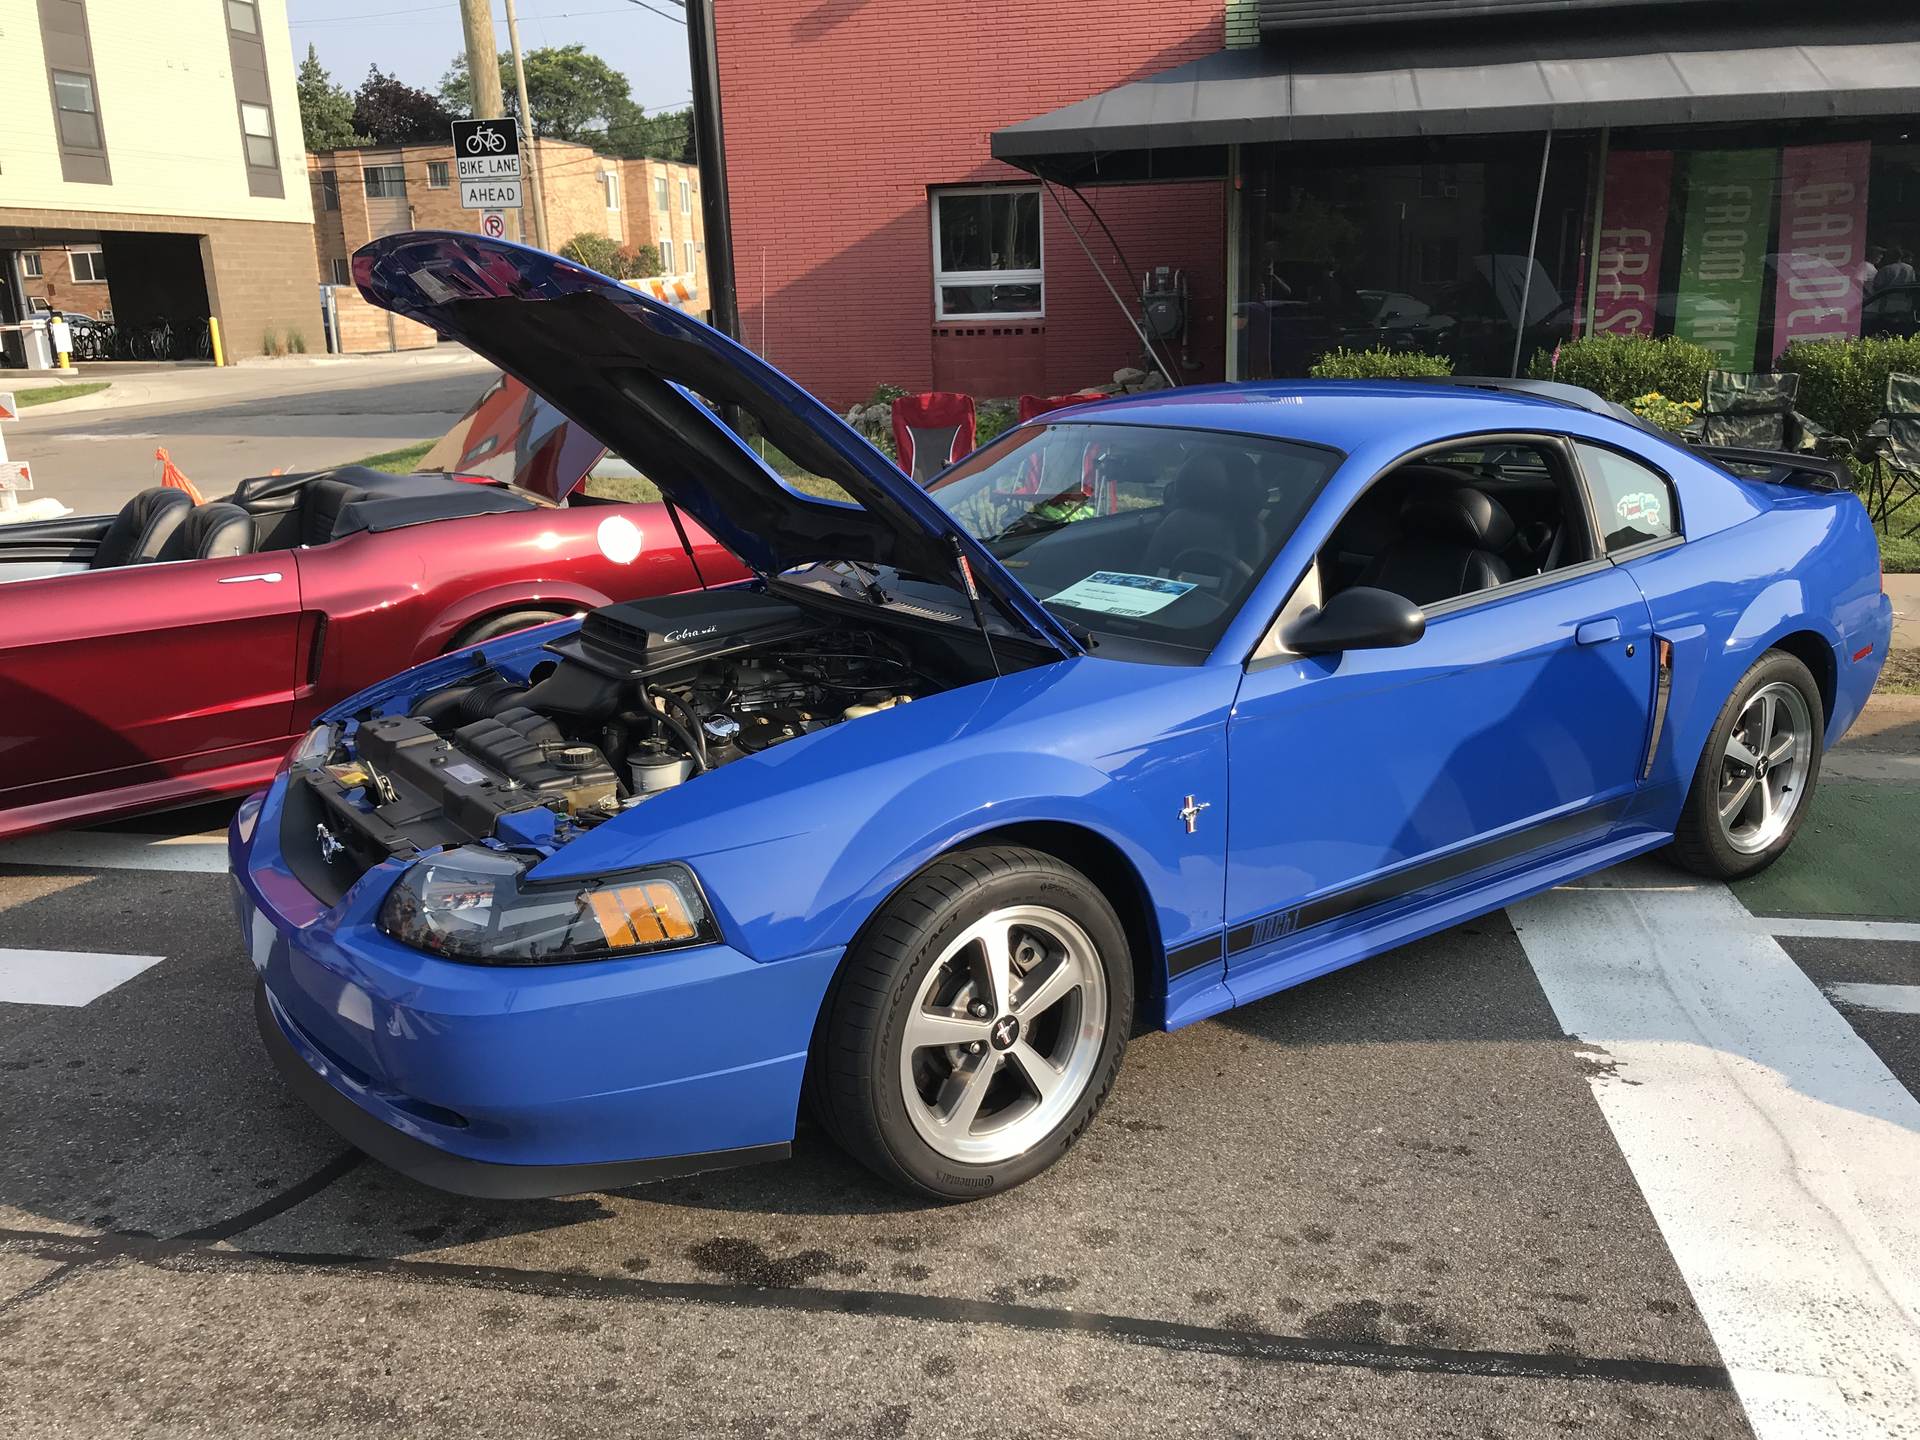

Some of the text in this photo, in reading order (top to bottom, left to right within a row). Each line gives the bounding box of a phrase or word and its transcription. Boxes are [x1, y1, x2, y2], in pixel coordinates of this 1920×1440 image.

[459, 158, 518, 175] BIKE LANE
[469, 188, 515, 202] AHEAD
[1698, 184, 1753, 281] FROM
[663, 628, 699, 643] Cobra
